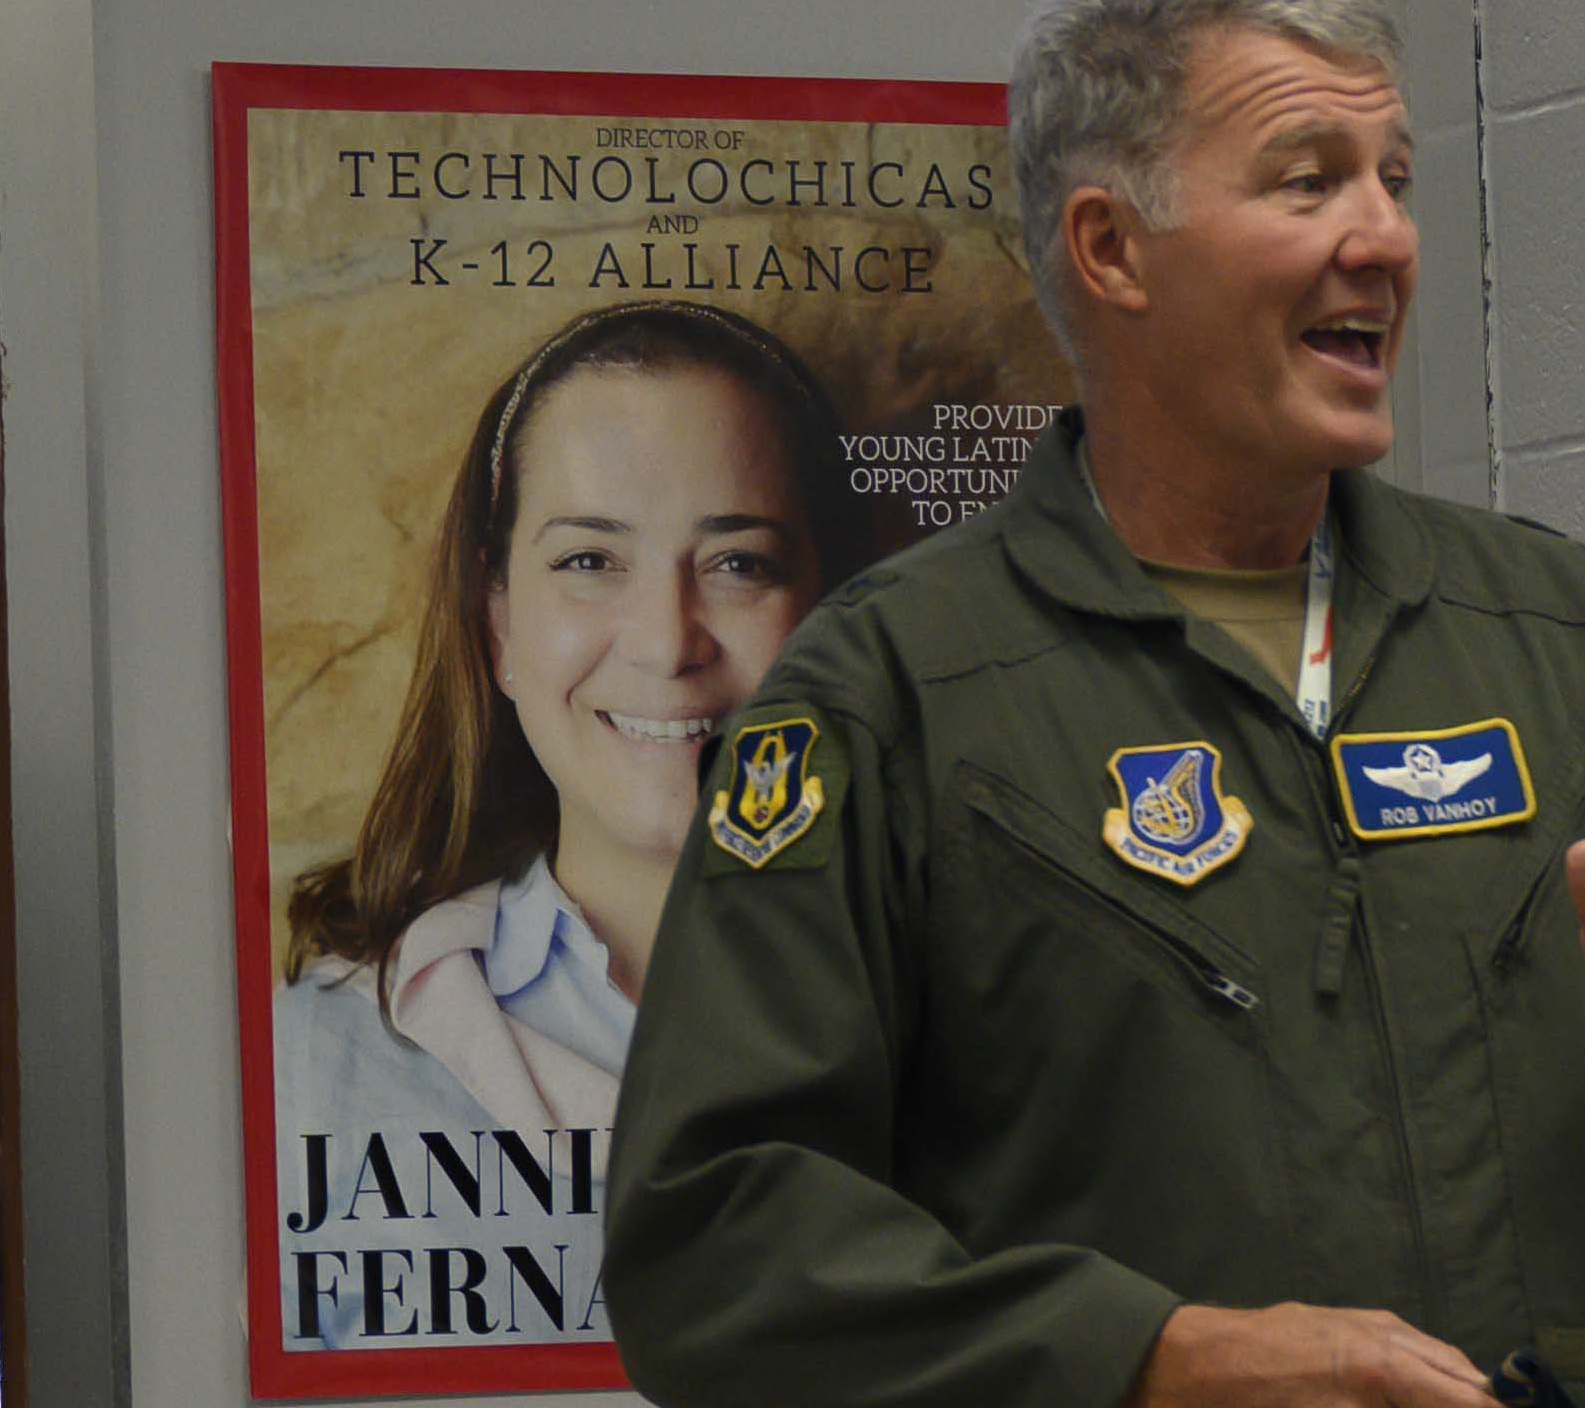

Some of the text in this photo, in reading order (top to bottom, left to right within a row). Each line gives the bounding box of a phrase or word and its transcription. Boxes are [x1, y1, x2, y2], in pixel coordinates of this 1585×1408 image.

[596, 127, 745, 151] DIRECTOR OF
[338, 150, 993, 210] TECHNOLOCHICAS
[646, 214, 700, 235] AND
[410, 239, 933, 293] K-12 ALLIANCE
[838, 435, 946, 462] YOUNG
[911, 500, 952, 526] TO
[1379, 797, 1497, 826] ROB VANHOY
[286, 1128, 615, 1234] JANNI
